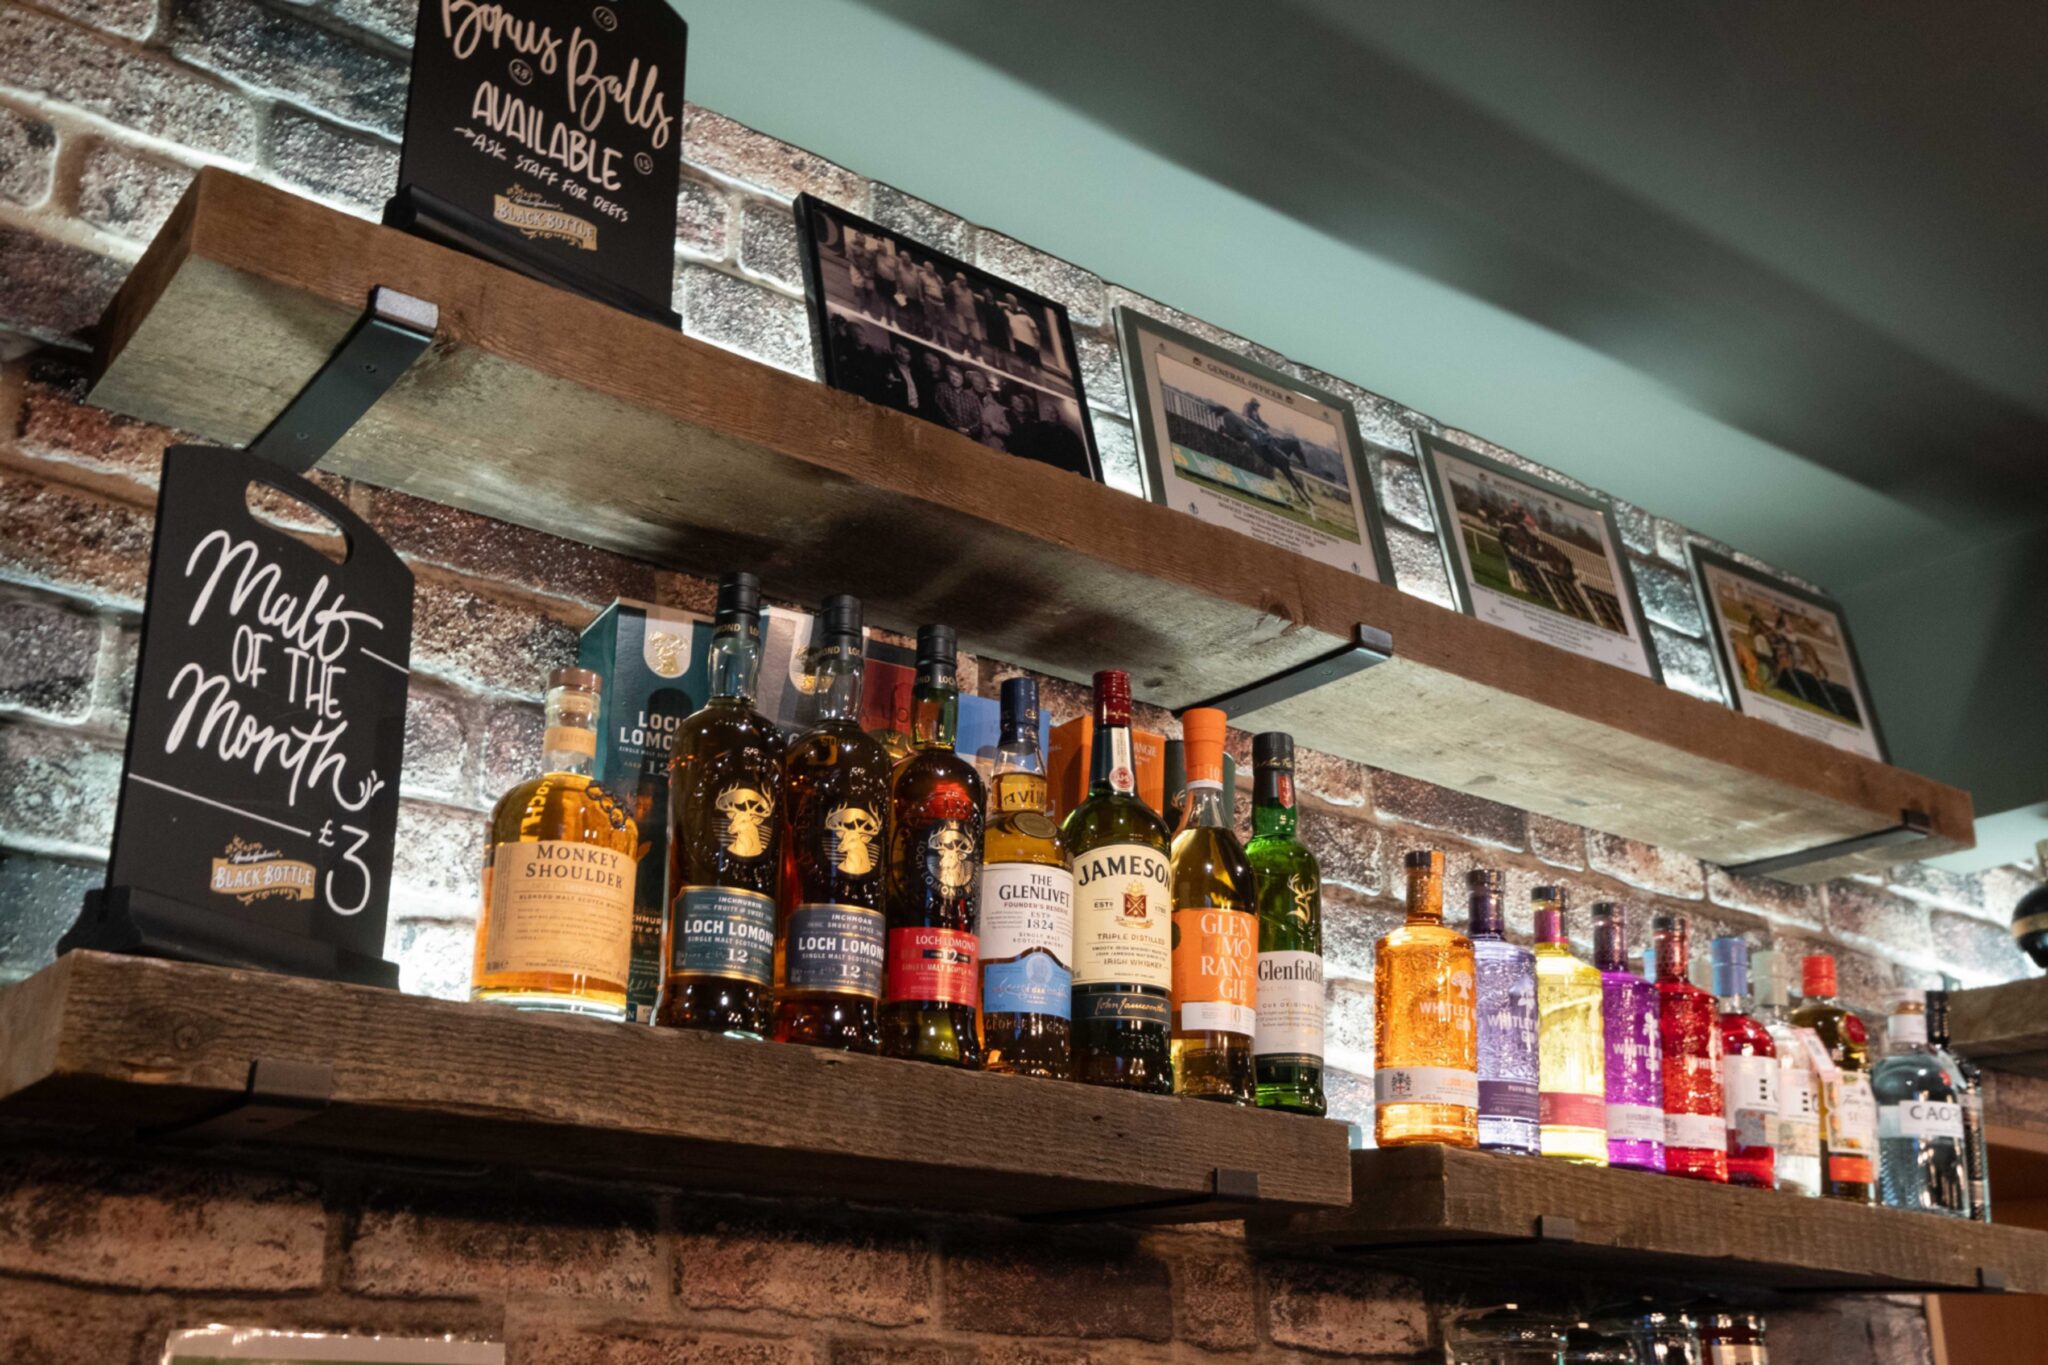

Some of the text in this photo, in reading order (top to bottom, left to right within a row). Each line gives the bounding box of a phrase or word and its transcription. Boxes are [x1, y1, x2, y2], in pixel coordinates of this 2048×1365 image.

[442, 0, 673, 149] Bonus Balls
[472, 81, 623, 190] AVAILABLE
[472, 133, 507, 161] ASK
[515, 155, 558, 186] STAFF
[562, 180, 588, 201] FOR
[592, 195, 629, 222] DEETS
[185, 529, 383, 662] Malt
[232, 624, 346, 720] OF THE
[166, 662, 384, 812] Month
[619, 727, 673, 751] LOMO
[536, 844, 619, 869] MONKEY
[213, 864, 313, 889] BLACK BOTTLE
[526, 862, 624, 890] SHOULDER
[1030, 873, 1053, 887] THE
[1078, 855, 1171, 893] JAMESON
[999, 884, 1071, 908] GLENLIVET
[1003, 901, 1044, 910] FOUNDER'S
[713, 904, 738, 913] FRUITY
[684, 919, 724, 934] LOCH
[827, 921, 850, 930] SMOKE
[1026, 918, 1054, 931] 1824
[1200, 912, 1251, 937] GLEN
[714, 936, 733, 945] MALT
[798, 936, 837, 951] LOCH
[915, 935, 976, 952] LOCH LOMOND
[1131, 934, 1166, 946] DISTILLED
[1221, 936, 1252, 960] MO
[725, 948, 749, 963] 12
[941, 947, 958, 965] 12
[1130, 959, 1162, 969] WHISKEY
[1201, 955, 1243, 978] RAN
[839, 964, 861, 979] 12
[1218, 977, 1247, 1001] GIE
